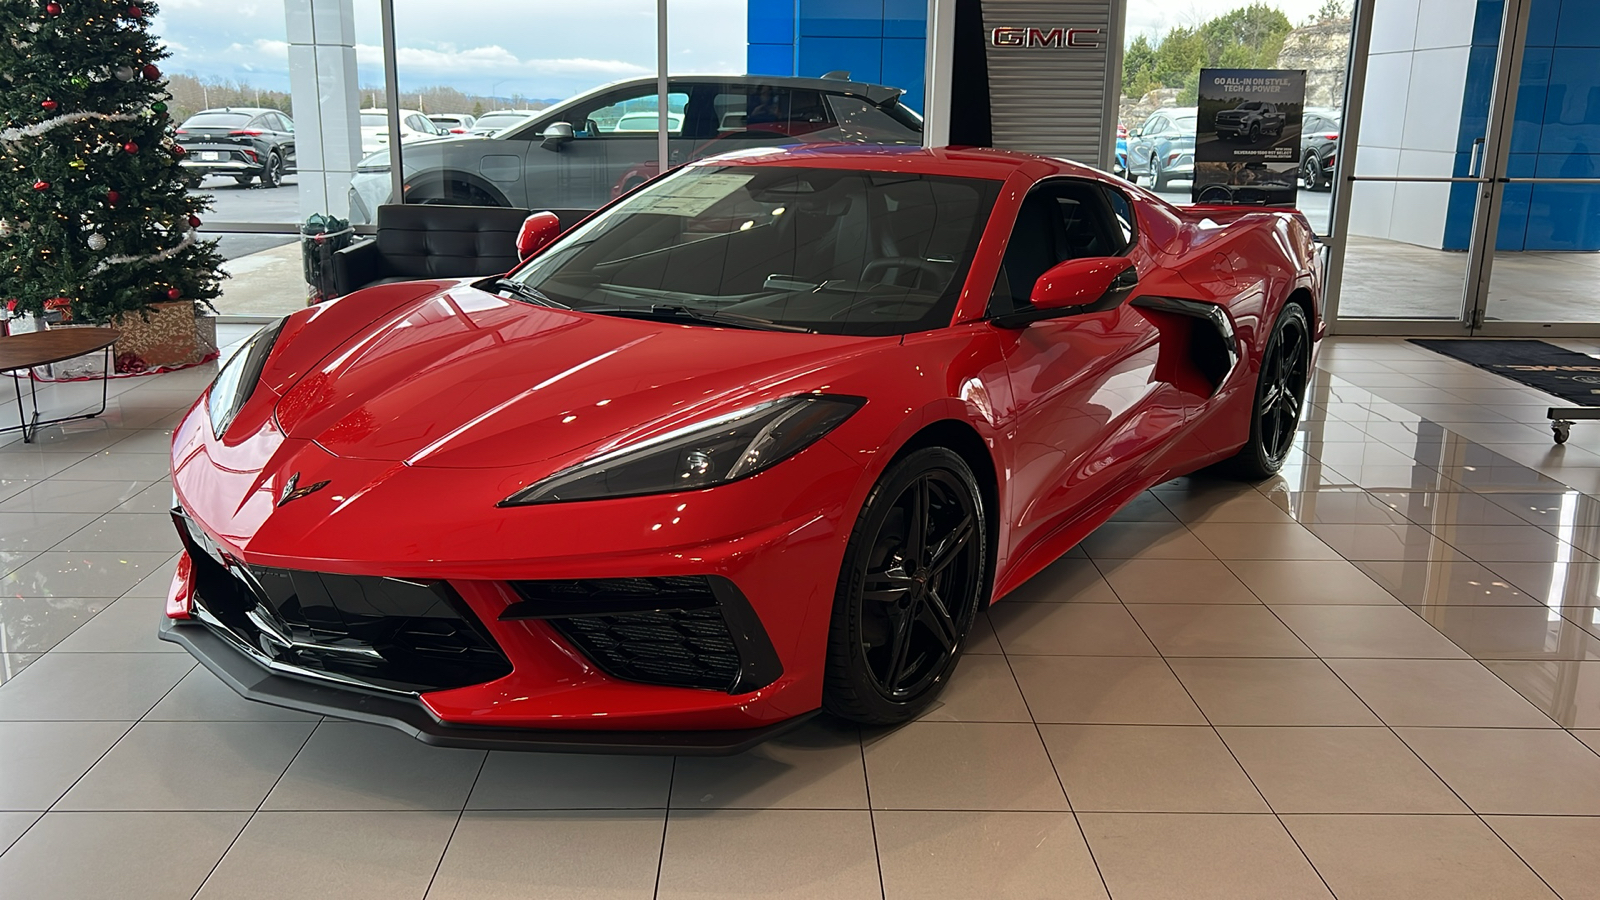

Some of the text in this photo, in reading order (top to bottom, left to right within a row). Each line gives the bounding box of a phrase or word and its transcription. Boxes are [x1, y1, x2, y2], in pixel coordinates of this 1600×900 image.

[991, 27, 1100, 48] GMC
[1265, 78, 1291, 86] STYLE,
[1252, 85, 1280, 93] POWER
